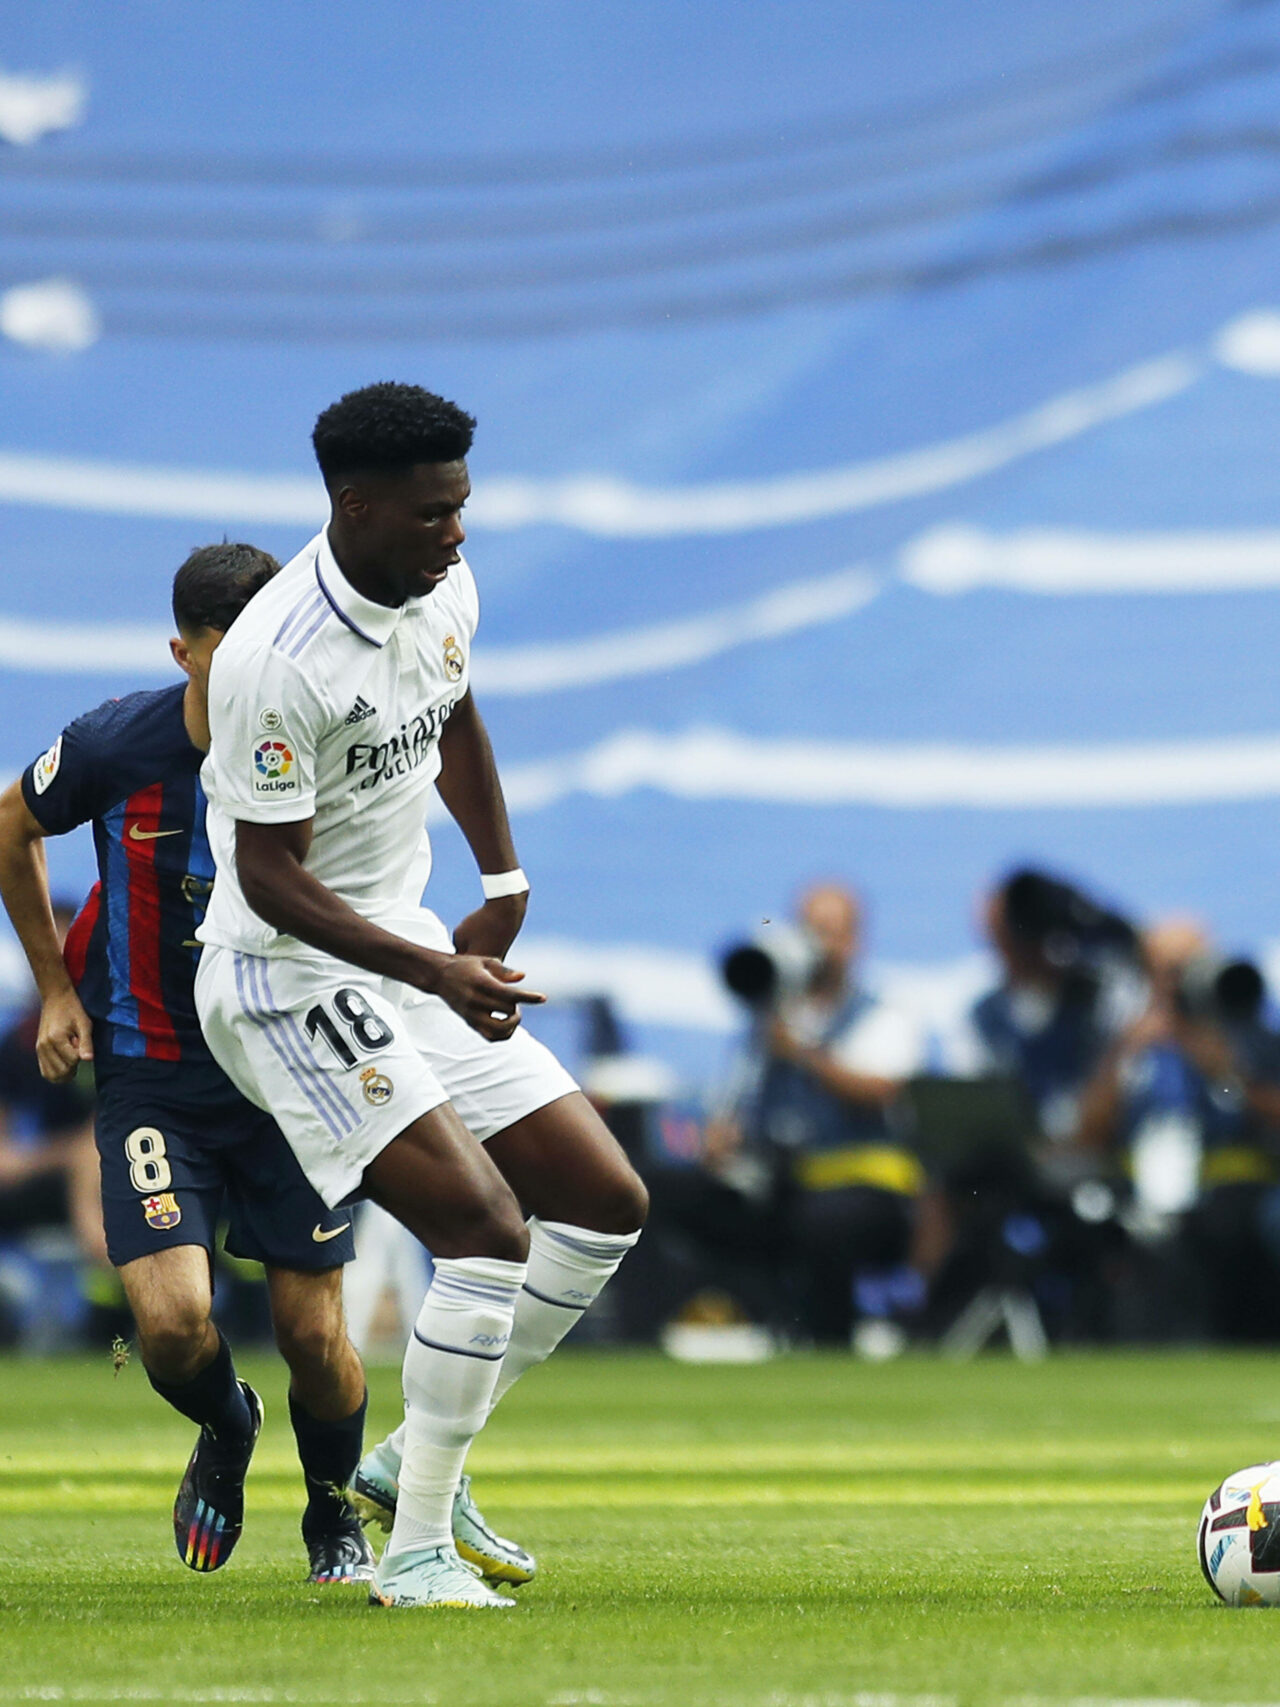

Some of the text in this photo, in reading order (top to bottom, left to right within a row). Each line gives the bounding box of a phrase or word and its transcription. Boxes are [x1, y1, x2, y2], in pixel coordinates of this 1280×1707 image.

[256, 780, 295, 792] LaLiga
[304, 987, 394, 1072] 18
[125, 1126, 172, 1193] 8
